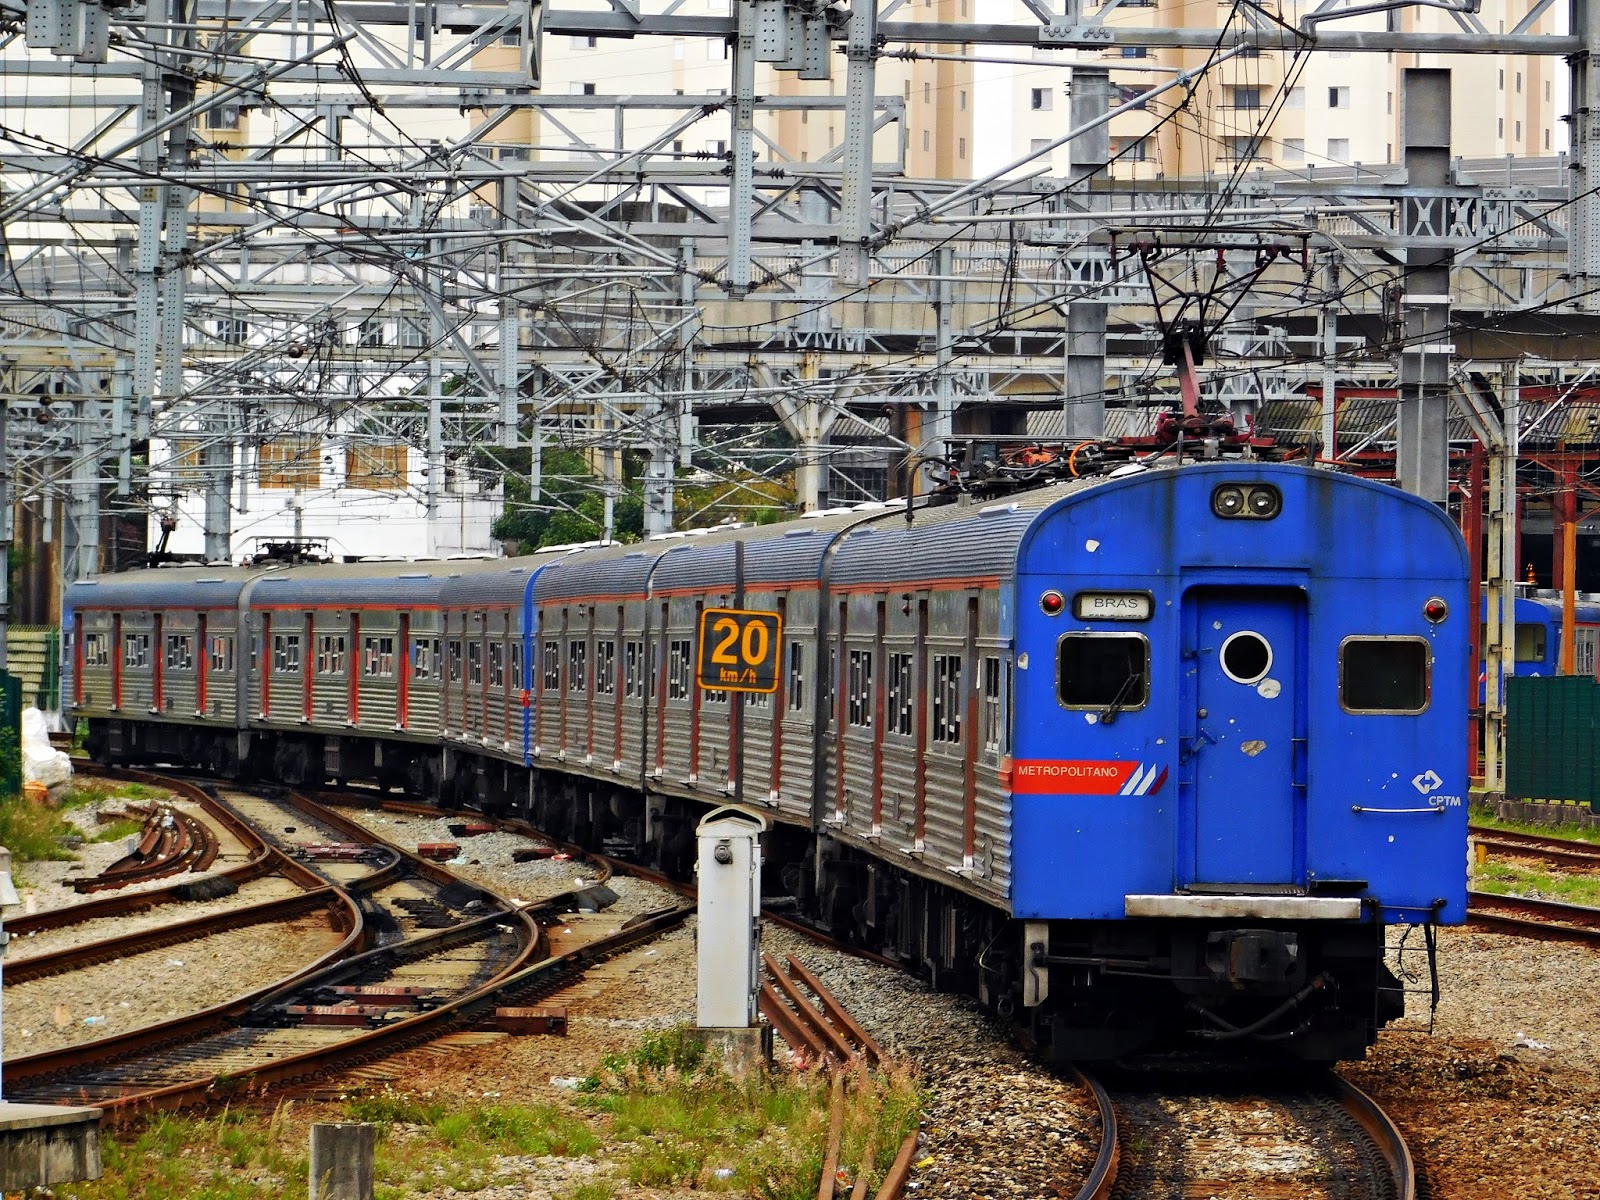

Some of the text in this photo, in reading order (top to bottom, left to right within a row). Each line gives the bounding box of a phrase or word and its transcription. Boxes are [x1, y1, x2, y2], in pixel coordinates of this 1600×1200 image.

[711, 617, 769, 666] 20
[719, 667, 757, 684] km/h
[1018, 765, 1118, 777] METROPOLITANO
[1428, 795, 1461, 806] CPTM
